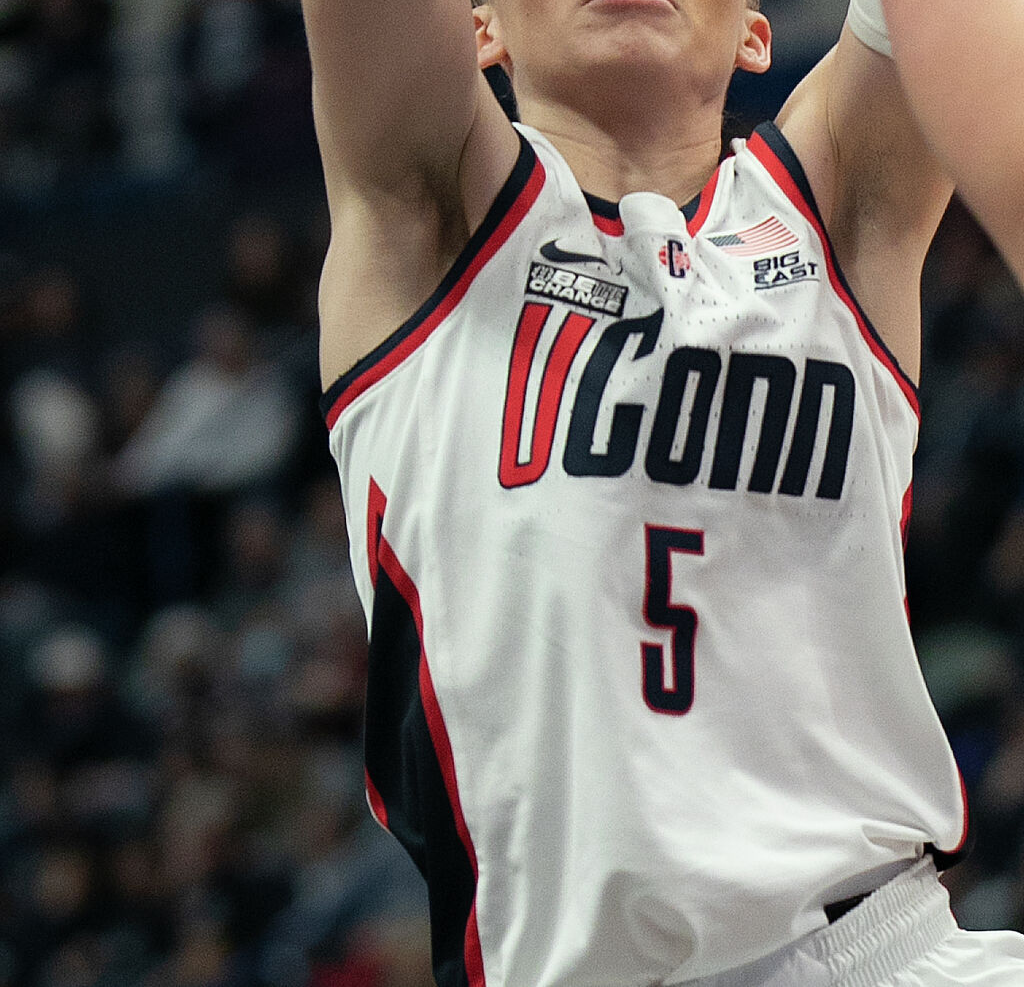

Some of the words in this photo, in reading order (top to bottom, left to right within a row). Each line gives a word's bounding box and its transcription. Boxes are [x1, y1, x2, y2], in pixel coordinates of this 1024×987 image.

[753, 251, 800, 272] BIG
[754, 263, 818, 285] EAST
[529, 279, 621, 313] CHANGE
[640, 522, 705, 716] 5
